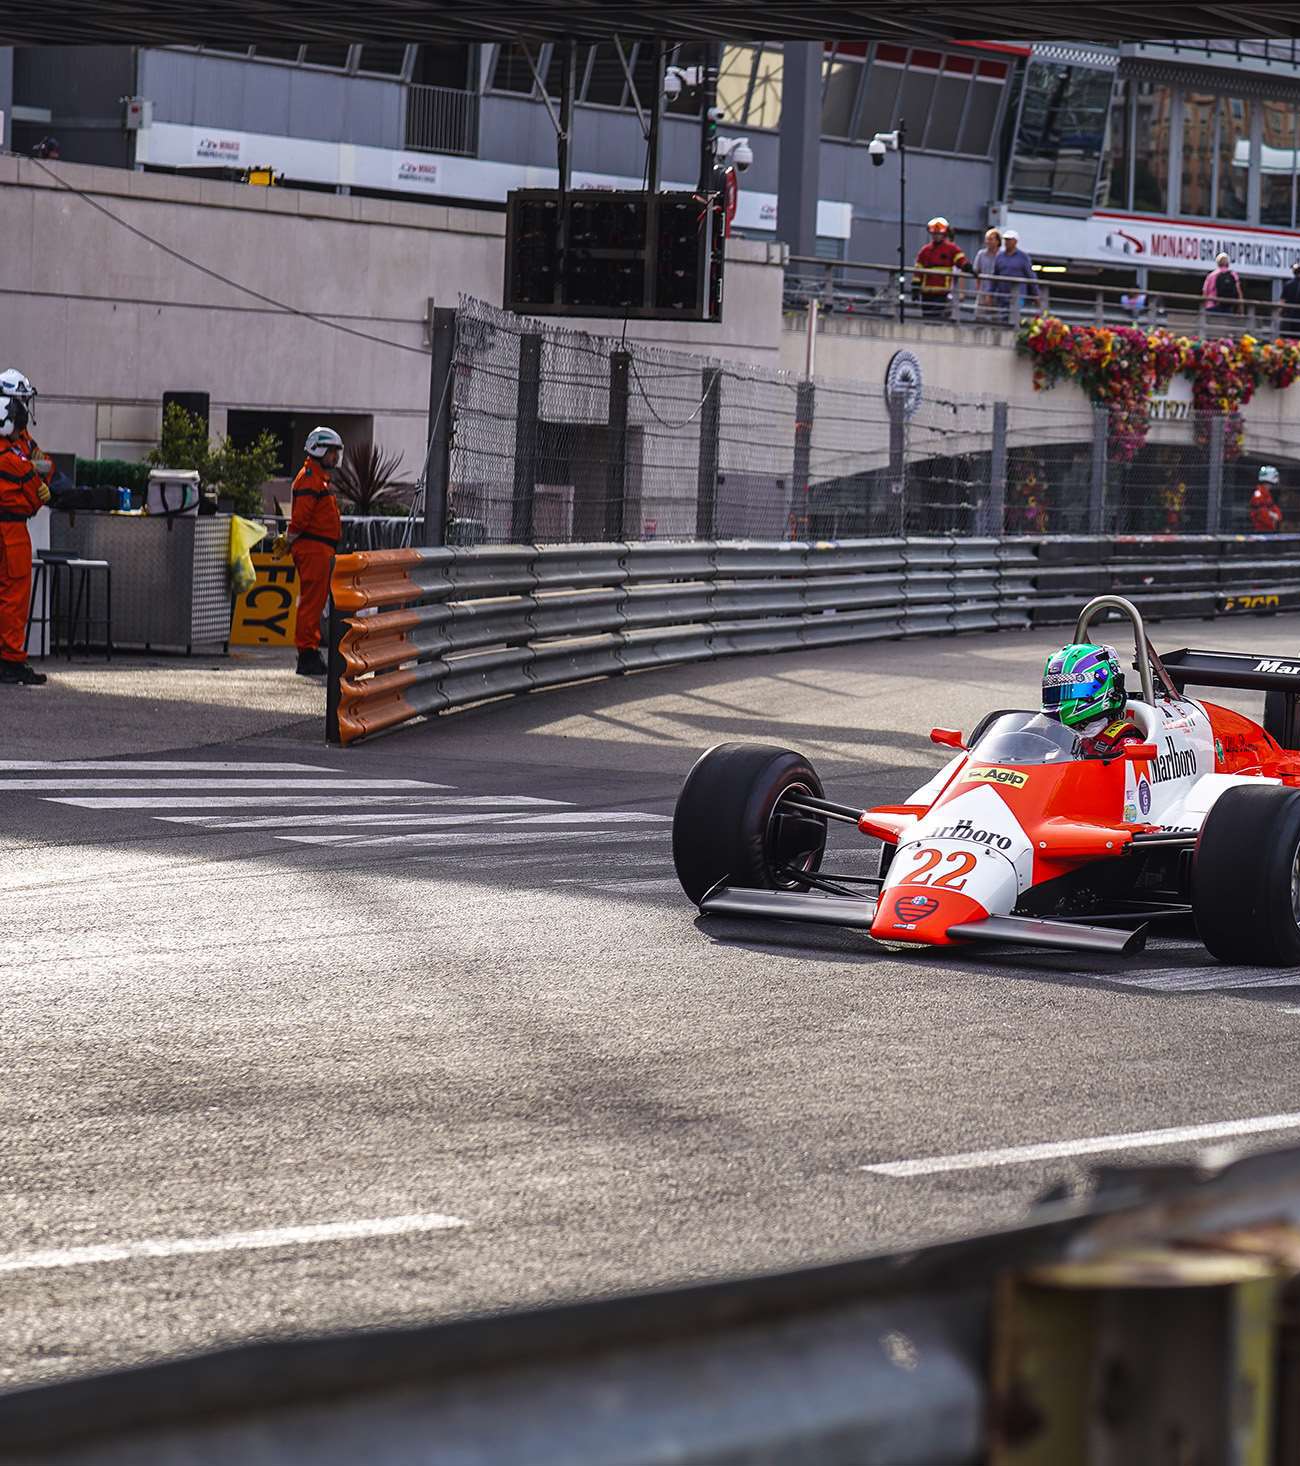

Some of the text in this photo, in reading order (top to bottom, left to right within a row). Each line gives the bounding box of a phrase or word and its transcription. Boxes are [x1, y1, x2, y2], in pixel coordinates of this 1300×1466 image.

[1152, 234, 1199, 260] MONACO
[1238, 242, 1263, 266] PRIX
[243, 565, 296, 637] FCY
[984, 769, 1025, 785] Agip
[1152, 736, 1197, 784] Marlboro
[926, 820, 1012, 850] rlboro
[898, 848, 977, 891] 22
